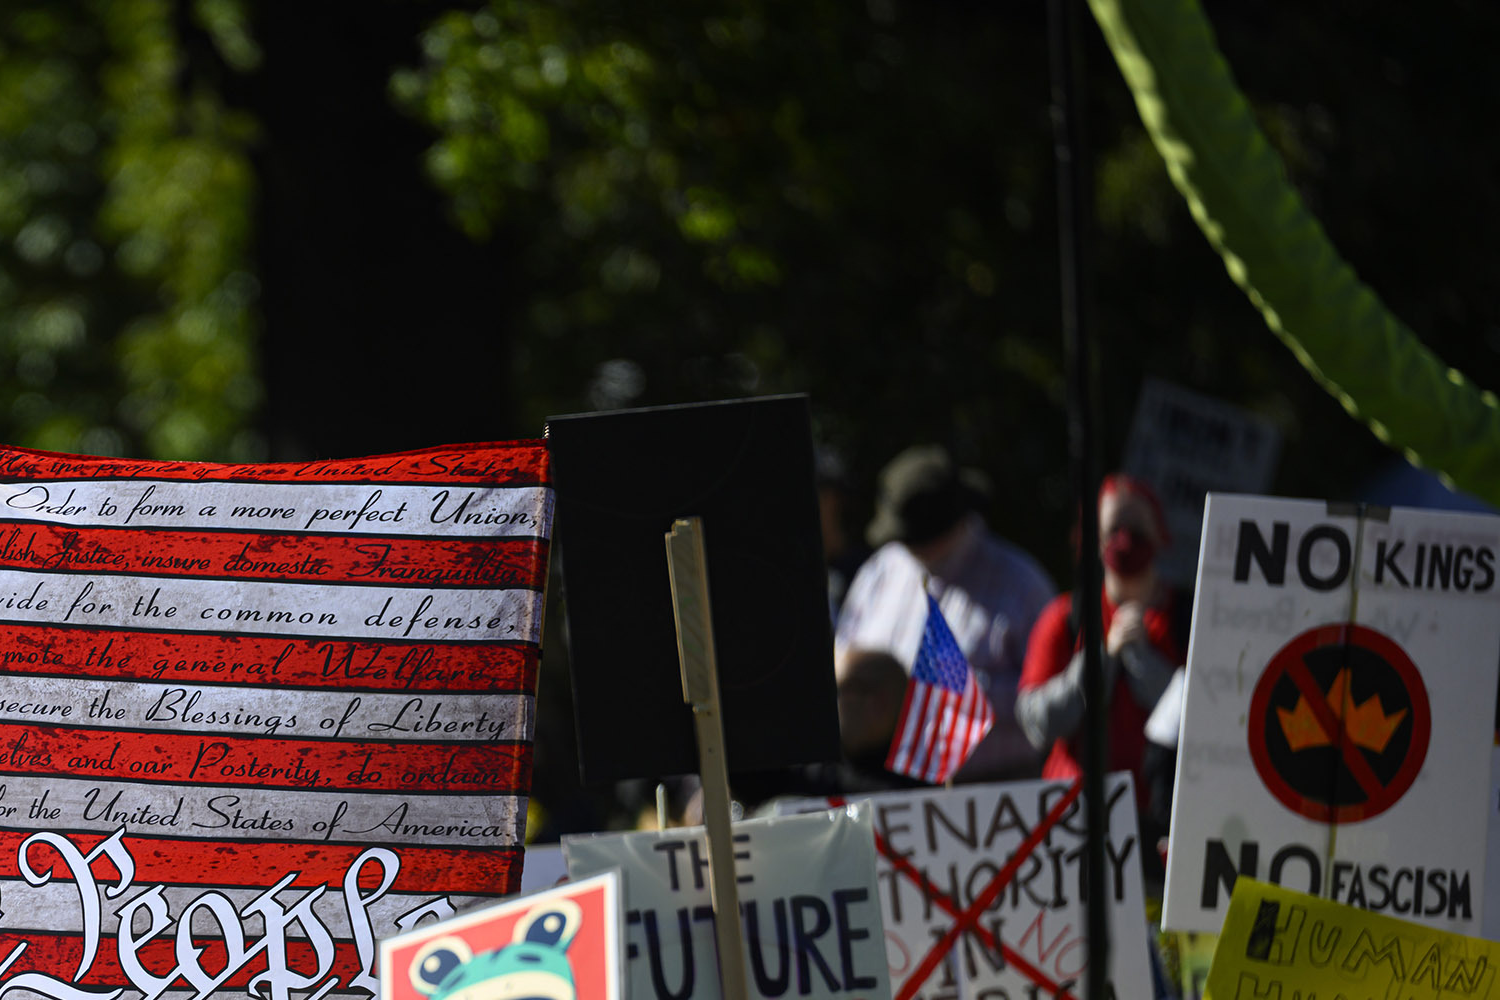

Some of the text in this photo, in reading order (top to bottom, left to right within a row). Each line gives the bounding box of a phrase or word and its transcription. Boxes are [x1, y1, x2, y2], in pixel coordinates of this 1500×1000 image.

[5, 485, 89, 517] Order
[97, 497, 118, 517] to
[124, 484, 186, 524] form
[199, 504, 216, 517] a
[230, 505, 296, 519] more
[304, 489, 408, 529] perfect
[429, 490, 539, 529] Union,
[42, 531, 130, 570] Justice,
[141, 548, 211, 571] insure
[223, 541, 332, 575] domestic
[1235, 518, 1496, 594] NO KINGS
[63, 581, 112, 622] for
[132, 587, 178, 618] the
[199, 608, 338, 626] common
[363, 594, 516, 637] defense,
[84, 638, 131, 669] the
[151, 643, 296, 680] general
[88, 689, 127, 721] the
[144, 687, 299, 737] Blessings
[319, 696, 362, 738] of
[366, 697, 507, 741] Liberty
[67, 741, 122, 771] and
[128, 754, 175, 774] our
[188, 741, 333, 787] Posterity,
[346, 752, 382, 784] do
[401, 753, 503, 786] ordain
[28, 791, 62, 821] the
[82, 786, 184, 828] United
[191, 794, 295, 832] States
[311, 801, 349, 841] of
[1200, 838, 1473, 920] NO FASCISM
[1246, 897, 1488, 995] HUMAN
